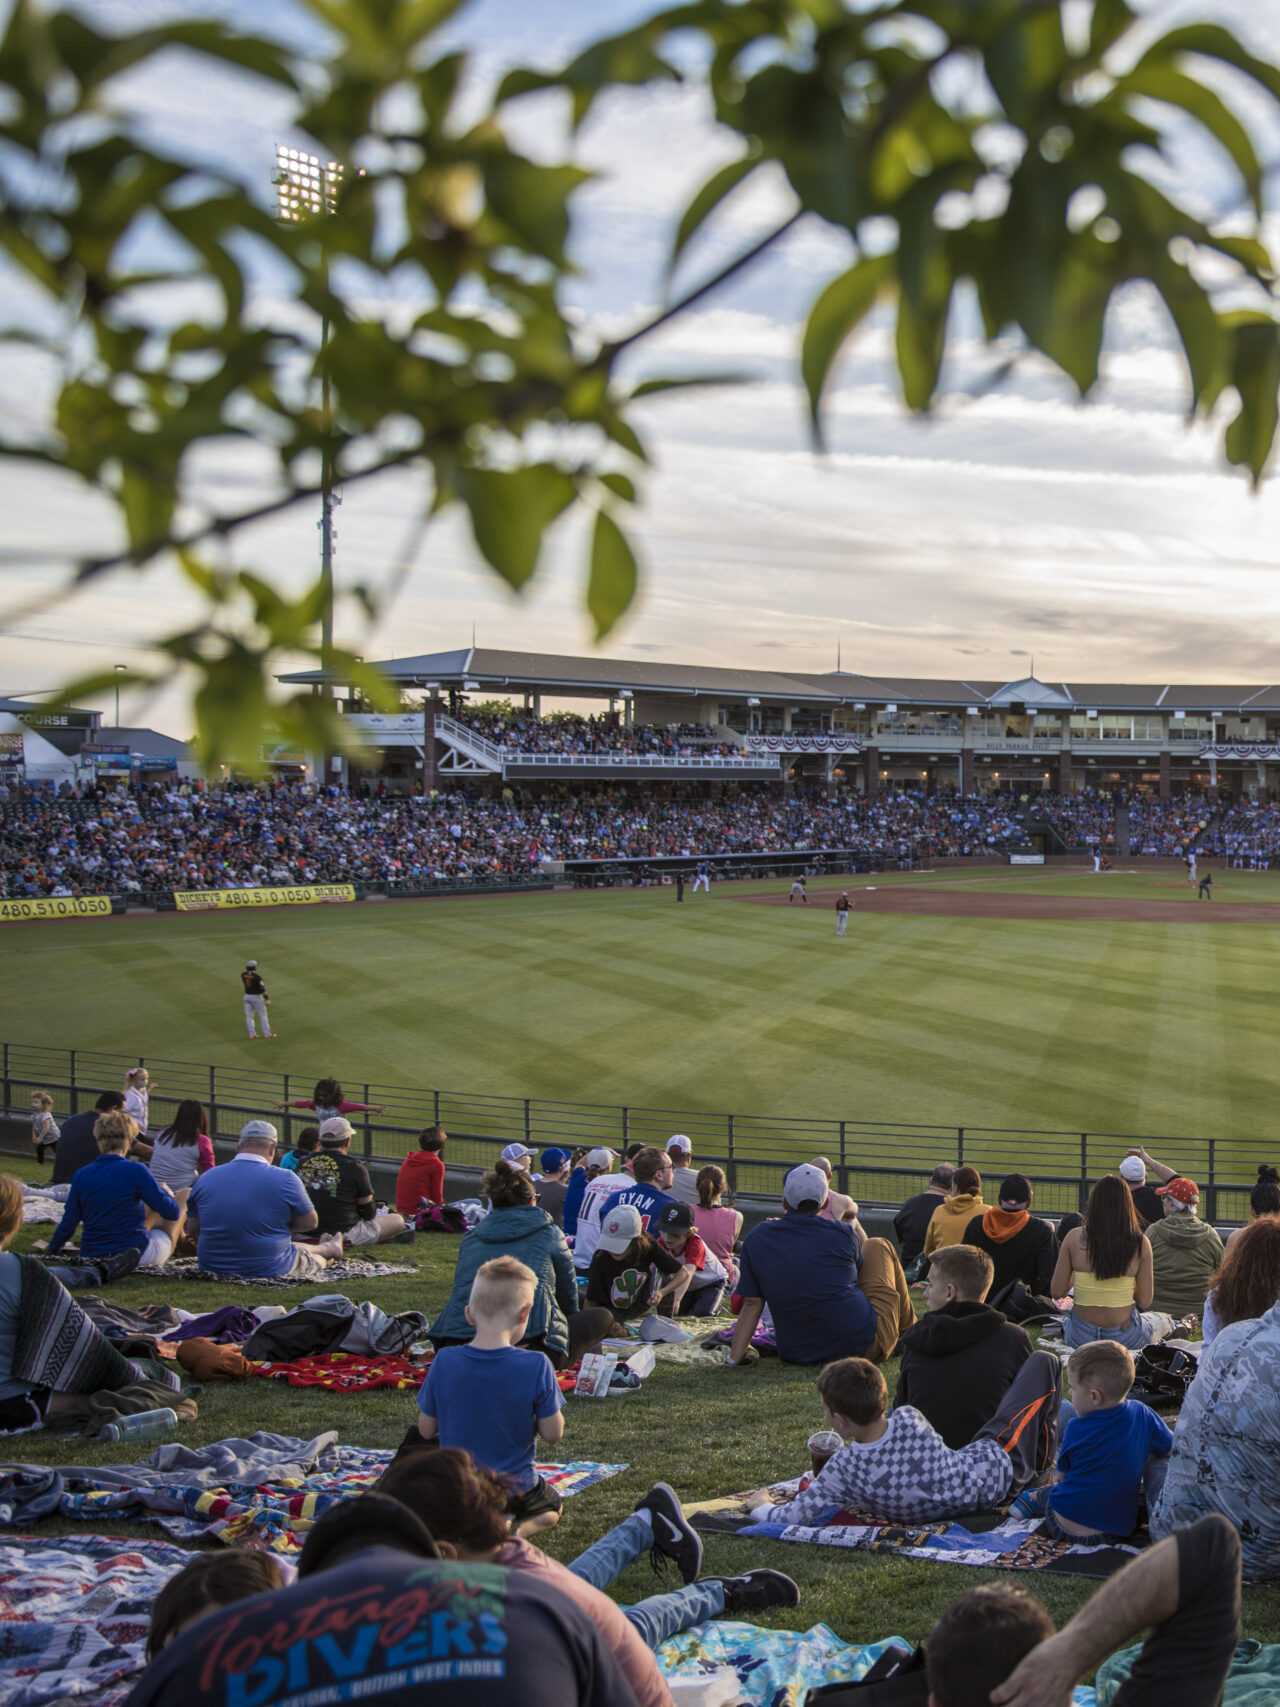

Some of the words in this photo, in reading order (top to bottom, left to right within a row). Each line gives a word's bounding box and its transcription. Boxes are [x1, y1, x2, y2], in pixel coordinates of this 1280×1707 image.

[1, 900, 108, 917] 480.510.1050
[225, 889, 311, 905] 480.510.1050
[618, 1192, 655, 1210] RYAN
[196, 1579, 483, 1692] Tortuga
[225, 1611, 508, 1707] DIVERS
[351, 1671, 406, 1699] BRITISH
[412, 1663, 454, 1683] WEST
[457, 1659, 502, 1678] INDIES
